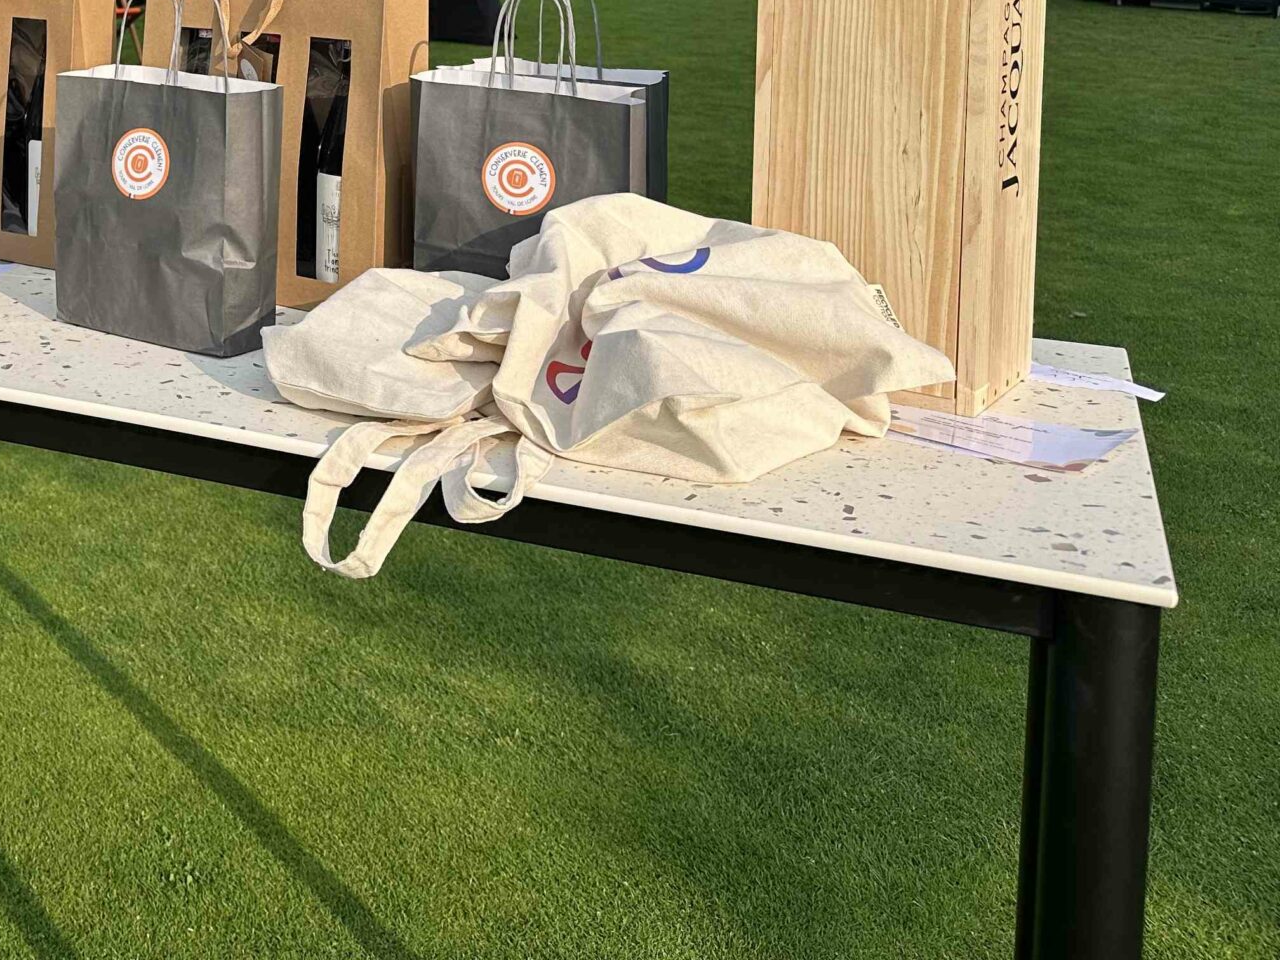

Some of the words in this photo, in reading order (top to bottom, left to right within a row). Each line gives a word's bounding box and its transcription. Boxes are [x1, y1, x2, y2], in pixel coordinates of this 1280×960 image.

[118, 135, 151, 162] CONSERVERIE
[489, 149, 529, 177] CONSERVERIE
[874, 288, 900, 329] RECYCLED
